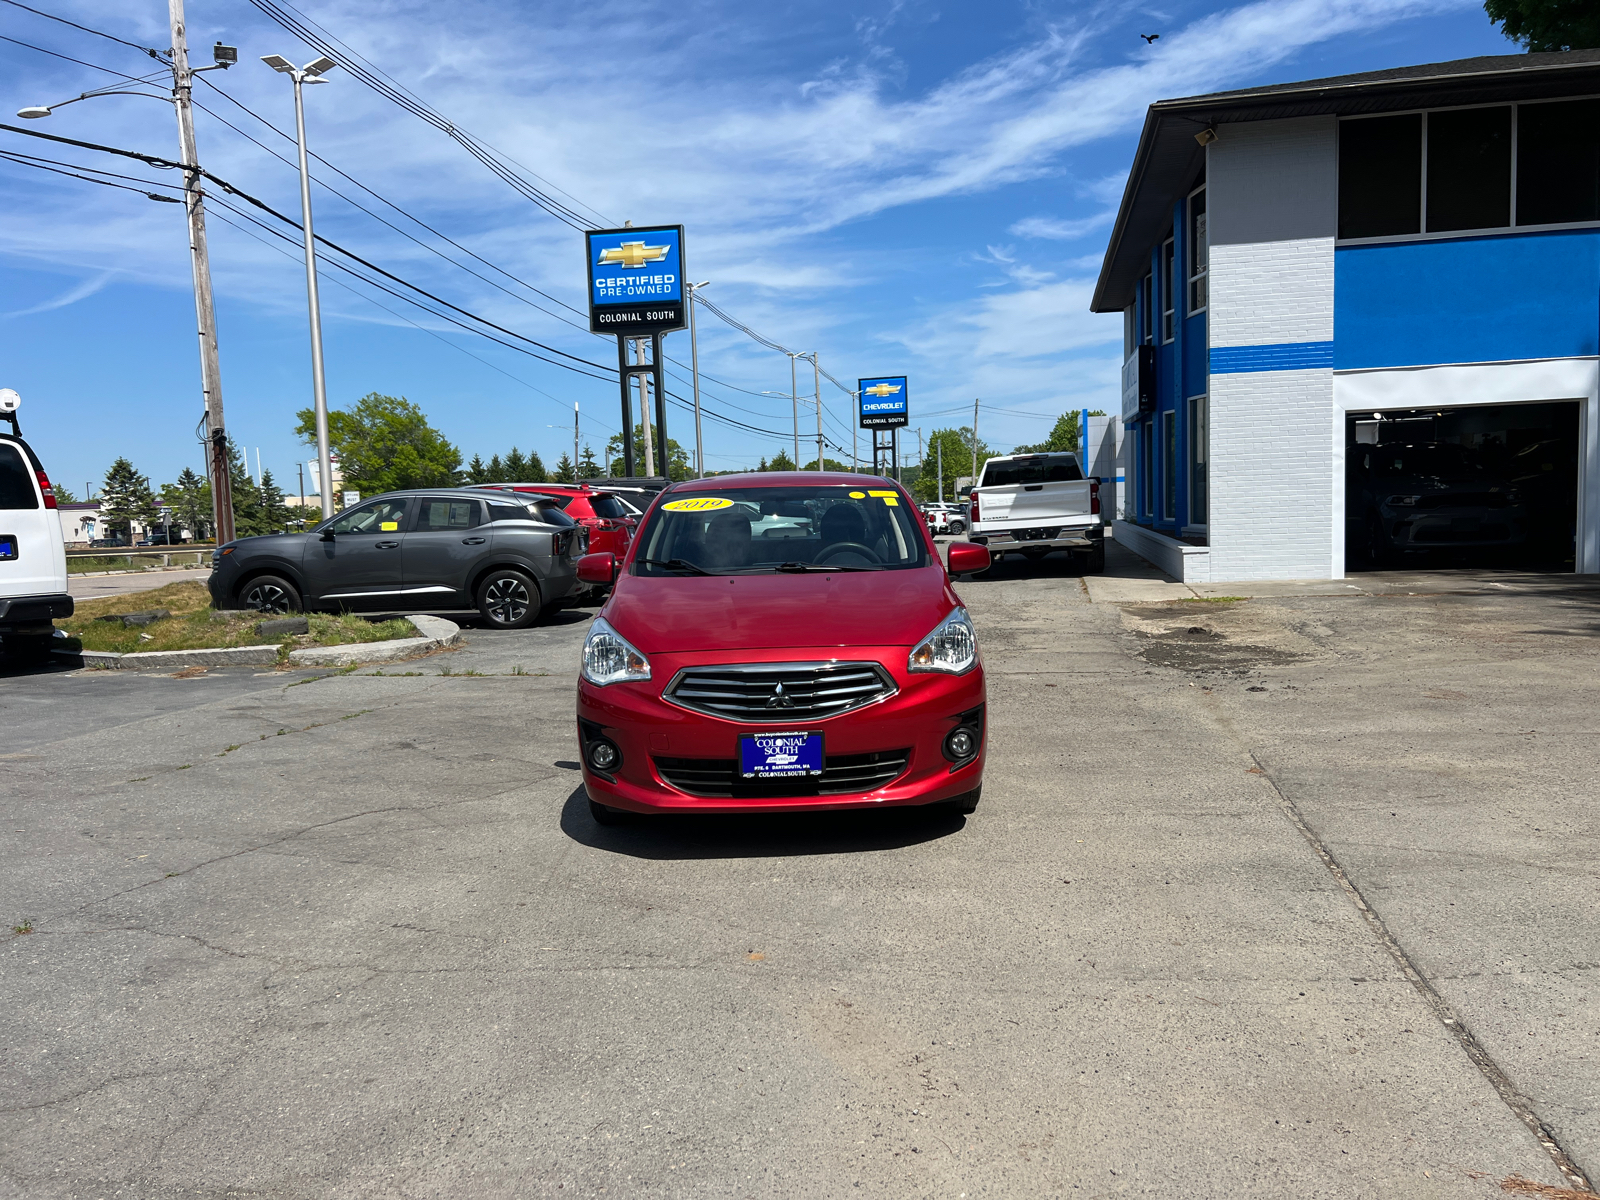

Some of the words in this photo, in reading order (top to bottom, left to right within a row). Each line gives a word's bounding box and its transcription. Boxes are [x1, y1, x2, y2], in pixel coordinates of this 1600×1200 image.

[595, 274, 675, 287] CERTIFIED
[600, 284, 672, 296] PRE-OWNED
[599, 312, 642, 323] COLONIAL
[646, 310, 675, 320] SOUTH
[863, 402, 903, 410] CHEVROLET
[673, 500, 723, 509] 2019
[756, 738, 806, 748] COLONIAL
[764, 746, 799, 755] SOUTH
